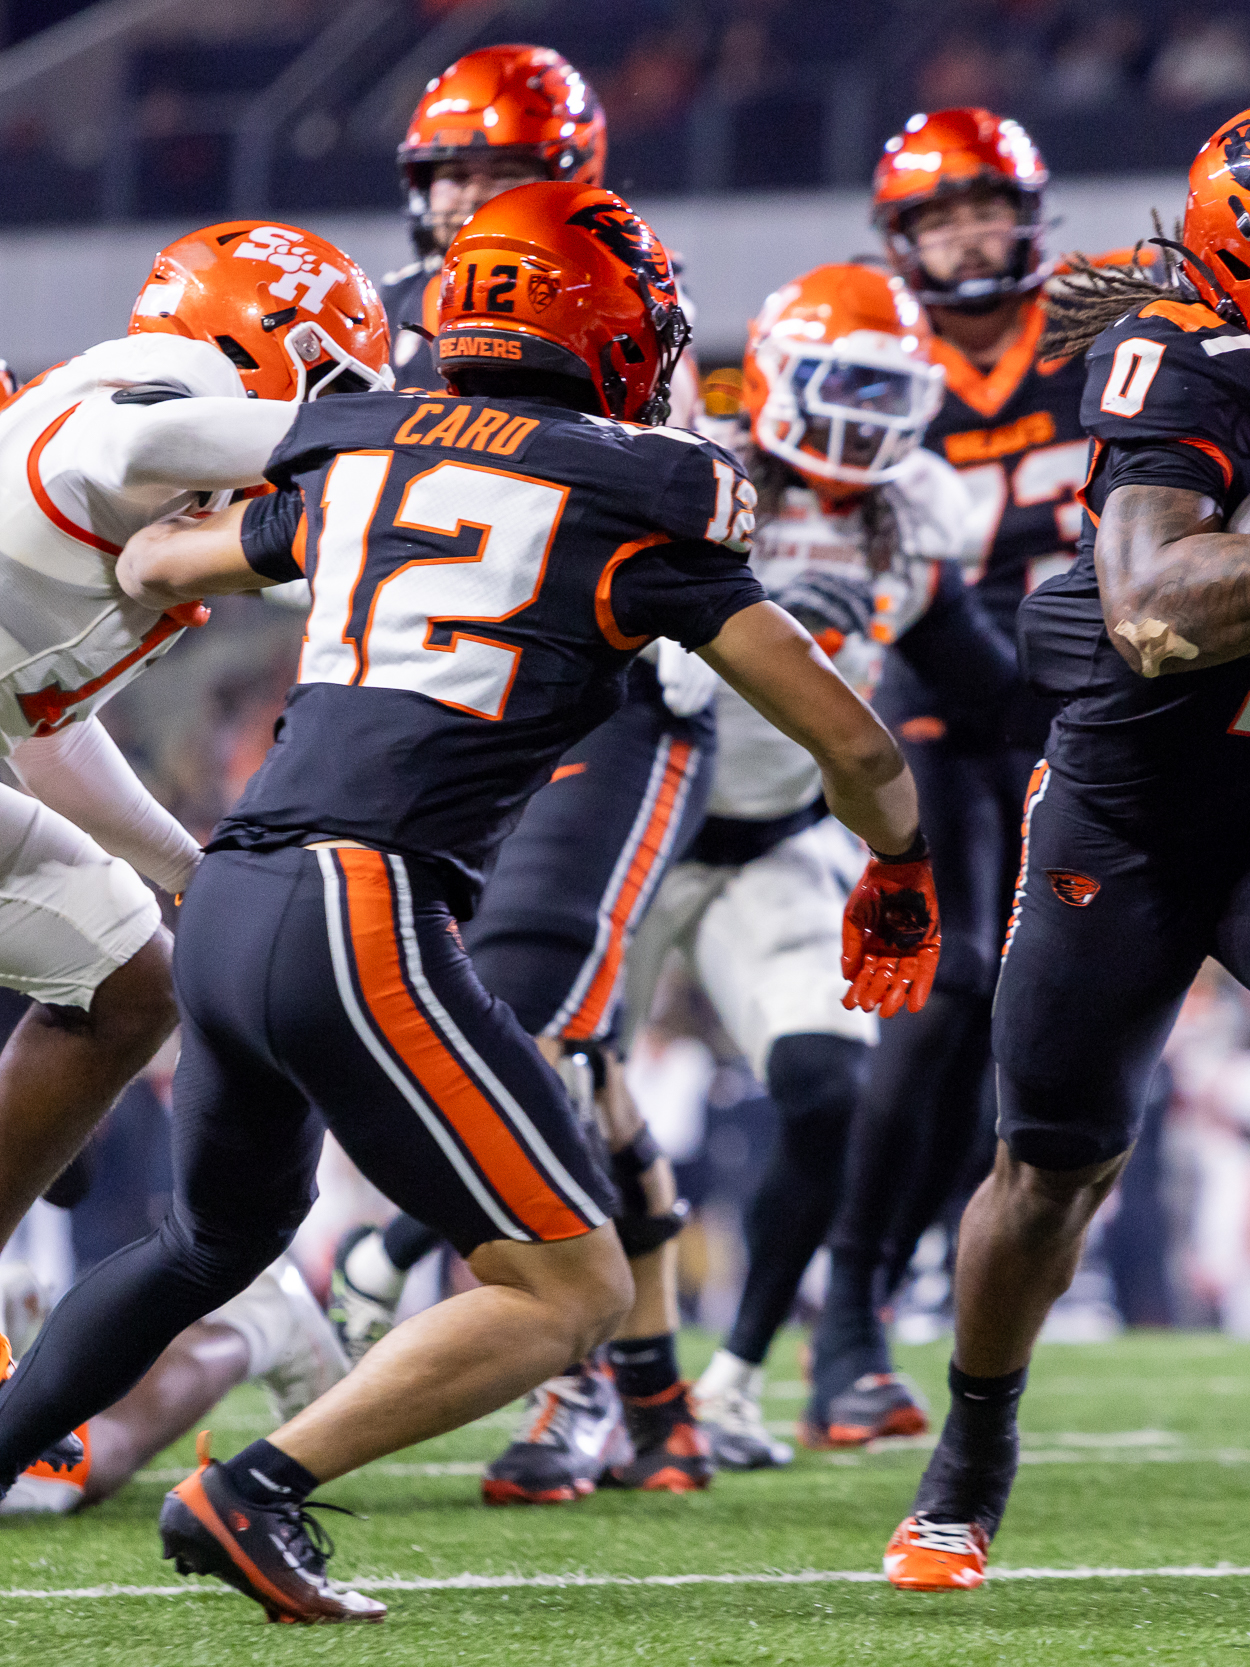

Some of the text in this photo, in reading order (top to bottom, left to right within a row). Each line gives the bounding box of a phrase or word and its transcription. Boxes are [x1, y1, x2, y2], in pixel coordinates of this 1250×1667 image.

[462, 263, 518, 313] 12
[439, 336, 522, 361] BEAVERS
[1100, 336, 1168, 419] 0
[297, 449, 572, 721] 12
